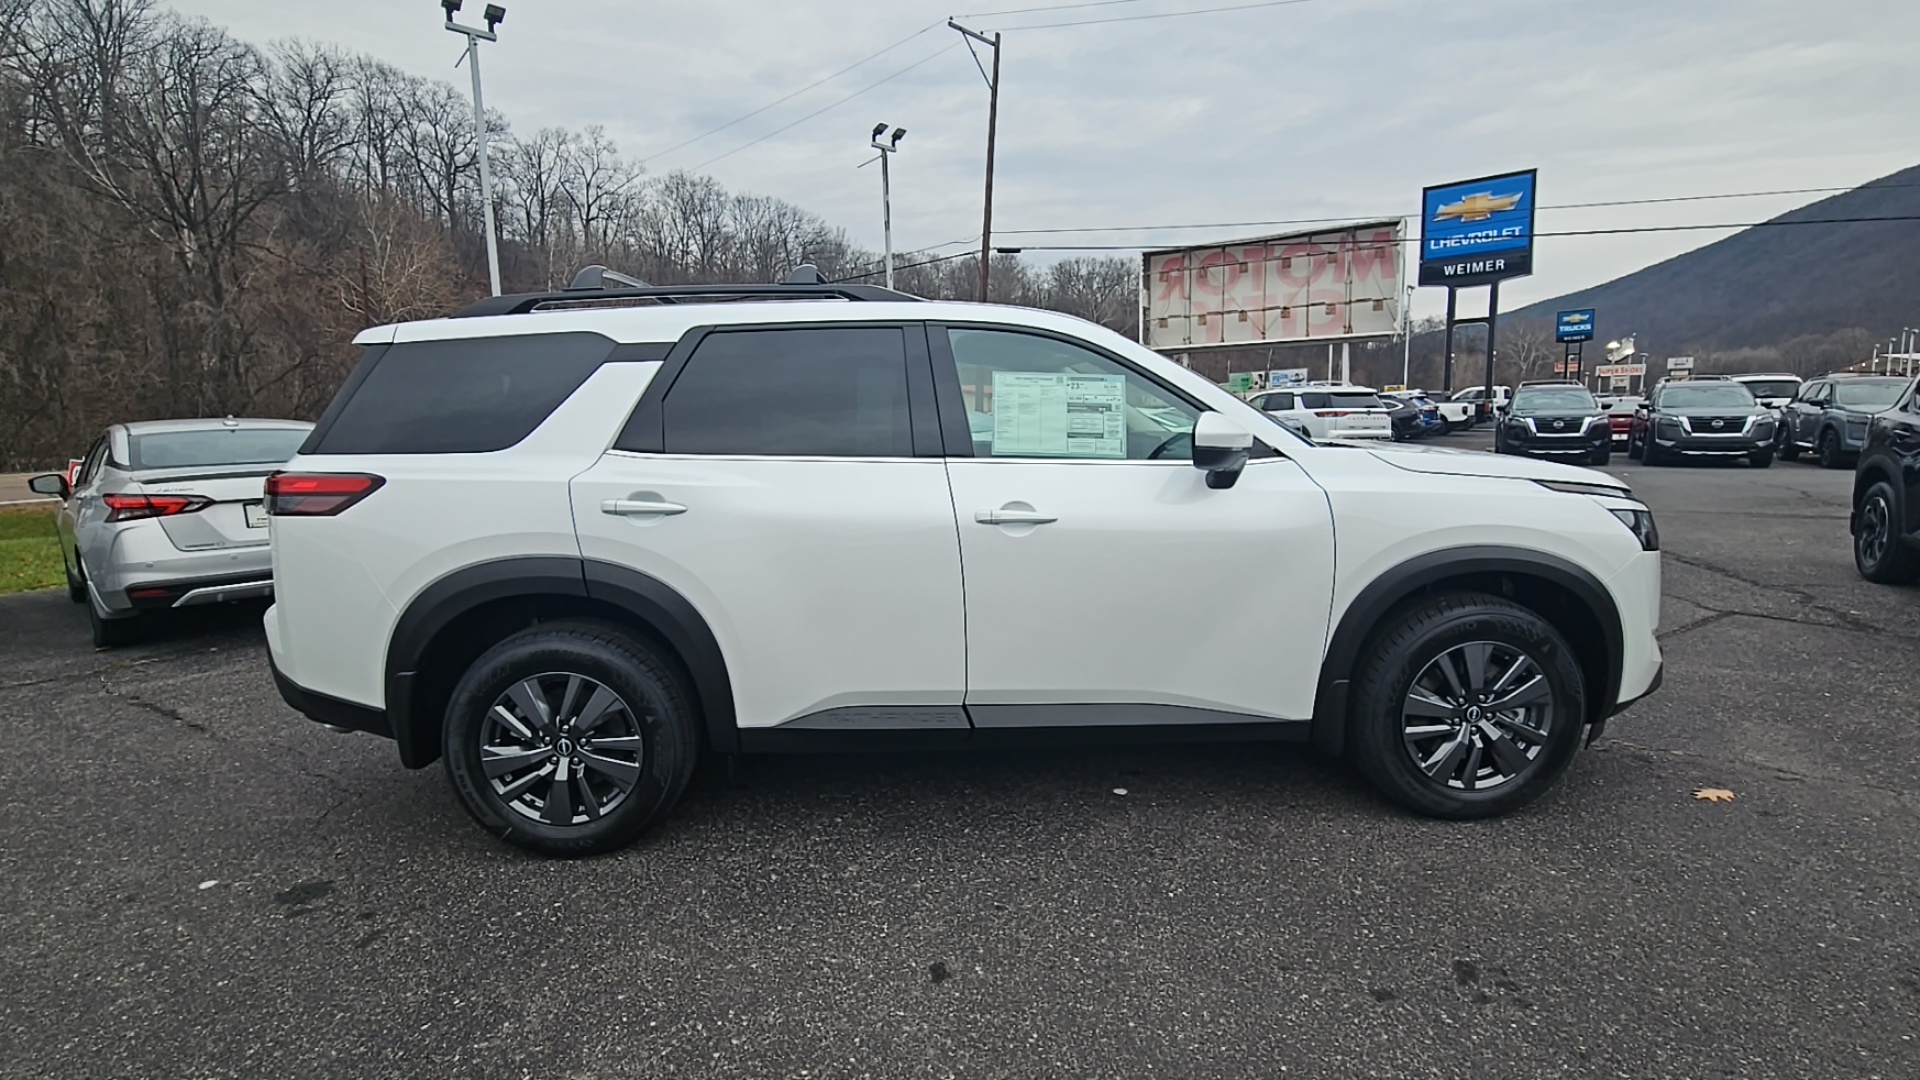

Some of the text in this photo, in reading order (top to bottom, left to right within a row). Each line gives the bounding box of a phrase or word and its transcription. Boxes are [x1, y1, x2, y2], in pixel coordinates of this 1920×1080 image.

[1430, 226, 1523, 250] CHEVROLET
[1443, 259, 1506, 276] WEIMER
[1559, 323, 1592, 332] TRUCKS
[827, 712, 962, 724] PATHFINDER
